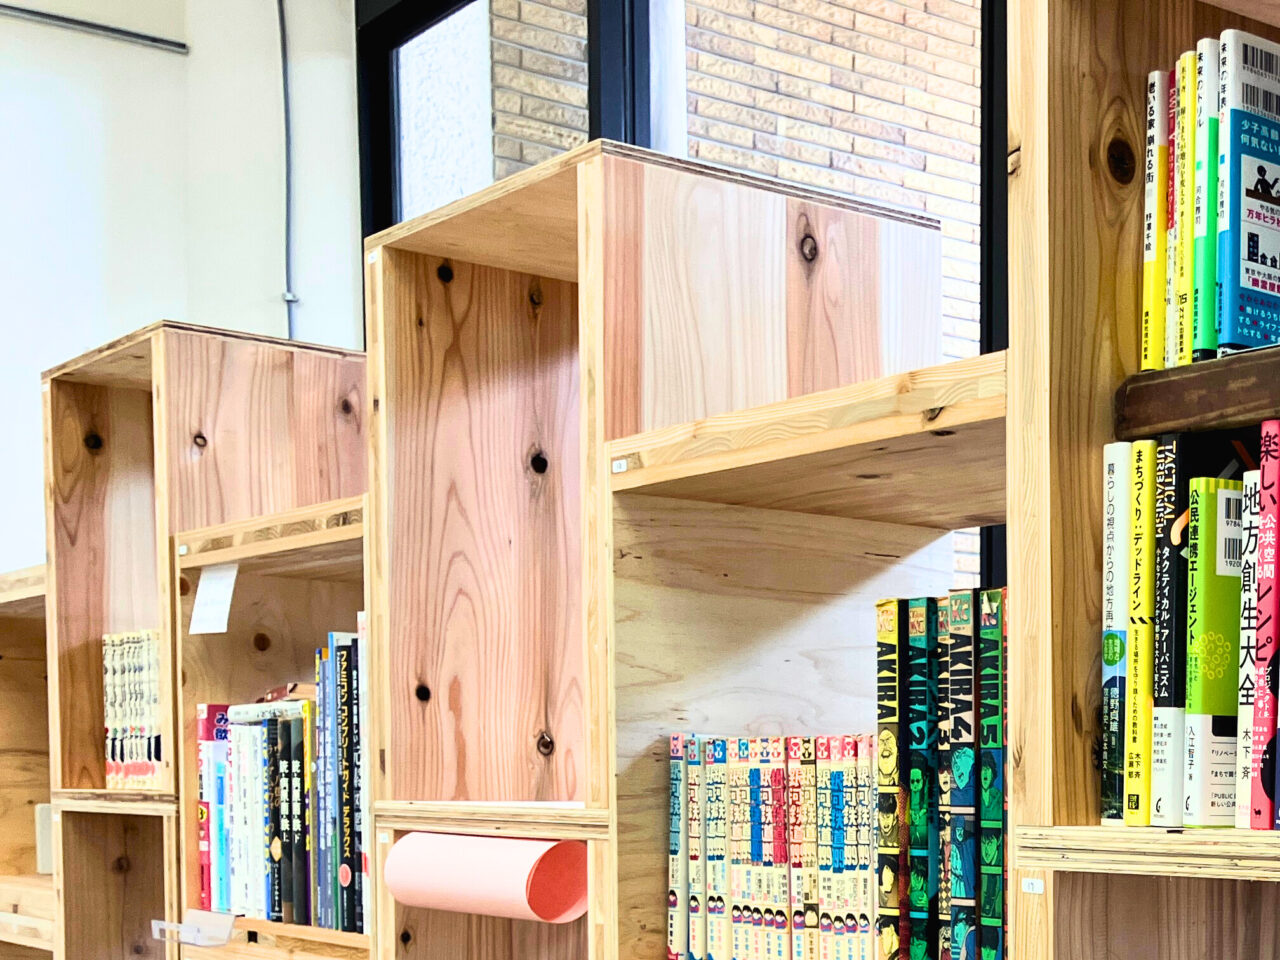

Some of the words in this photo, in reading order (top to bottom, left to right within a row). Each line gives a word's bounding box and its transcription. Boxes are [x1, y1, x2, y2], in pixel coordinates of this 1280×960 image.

[1155, 446, 1167, 538] URBANISM
[1164, 440, 1178, 519] TACTICAL
[1258, 431, 1280, 511] 楽しい
[1187, 489, 1200, 647] 公民連携のエージェント
[1262, 514, 1278, 579] 公共空間
[1239, 481, 1260, 706] 地方創生大全
[1256, 583, 1273, 662] レシピ
[877, 641, 897, 722] AKIRA
[909, 646, 928, 721] AKIRA
[950, 632, 974, 715] AKIRA
[980, 637, 1000, 721] AKIRA
[911, 726, 926, 746] 2
[951, 716, 973, 741] 4
[981, 724, 998, 746] 5
